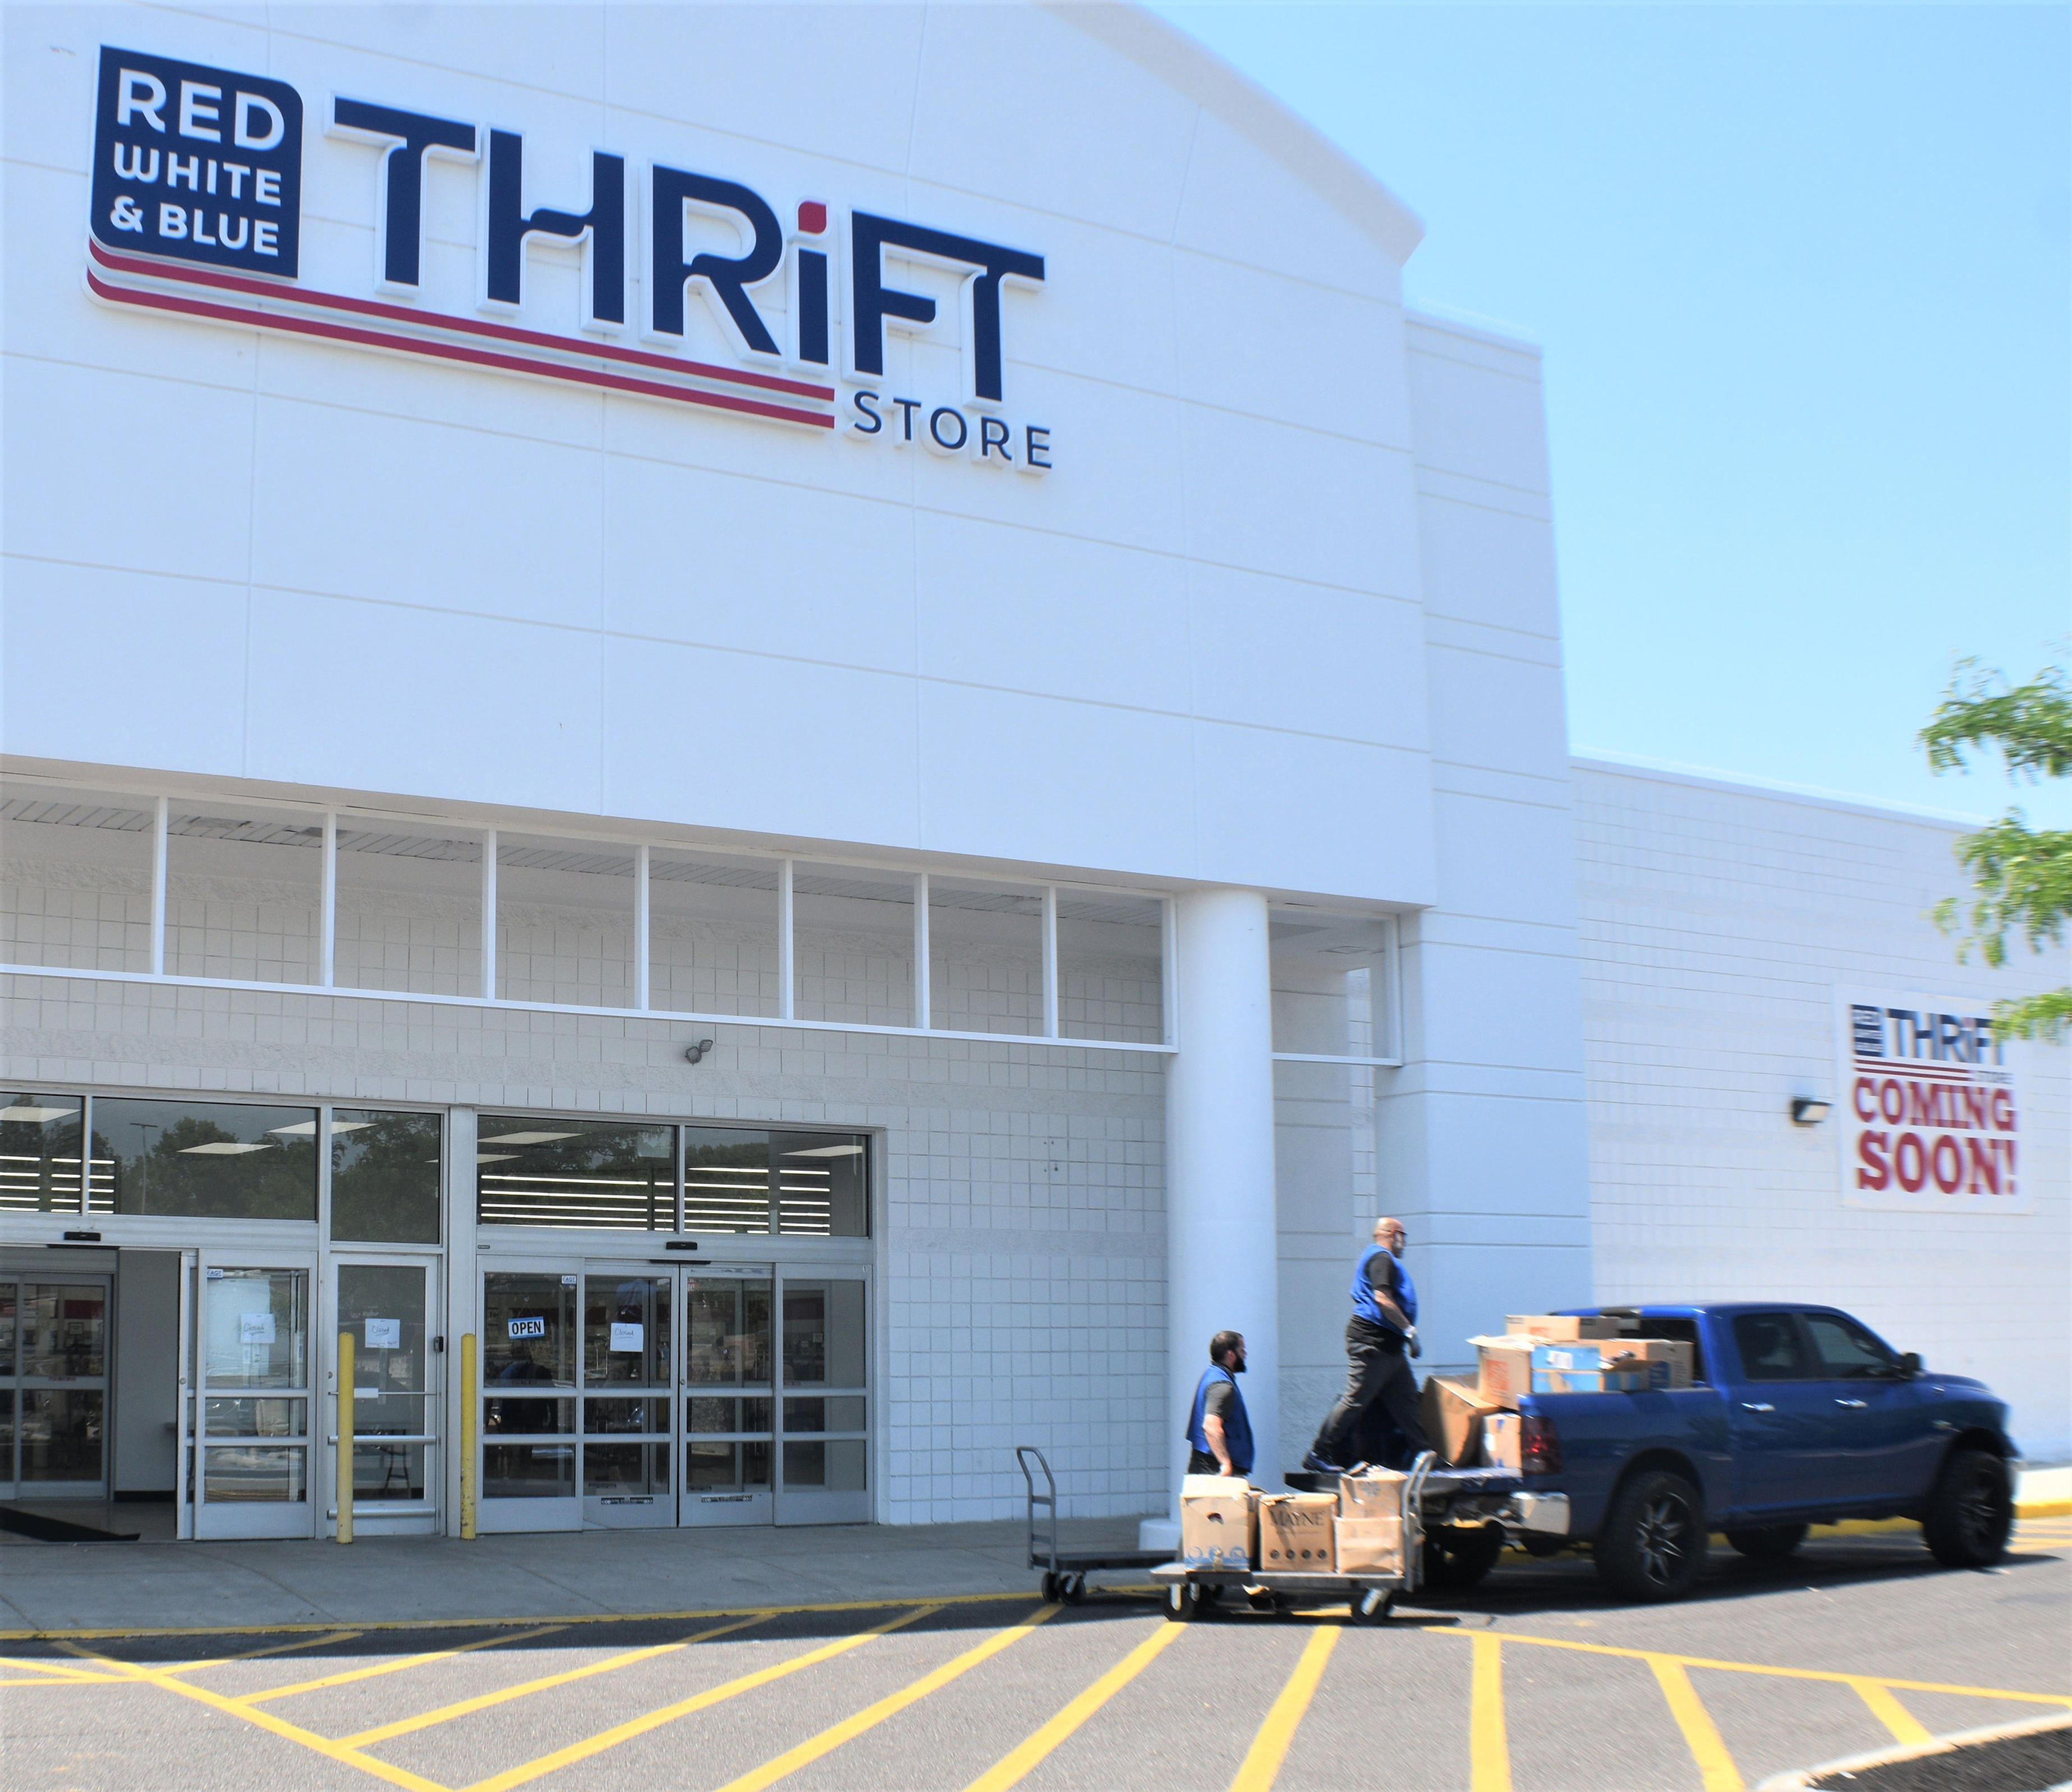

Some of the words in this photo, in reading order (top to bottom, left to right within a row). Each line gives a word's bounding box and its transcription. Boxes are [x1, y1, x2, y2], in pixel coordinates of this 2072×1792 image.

[117, 67, 285, 151] RED
[113, 142, 282, 207] WHITE
[110, 195, 144, 233] &
[159, 202, 279, 257] BLUE
[853, 390, 1053, 470] STORE
[1854, 1077, 2017, 1132] COMING
[1856, 1129, 2018, 1195] SOON!
[244, 1322, 265, 1332] Closed
[371, 1325, 389, 1334] Closed
[512, 1321, 541, 1335] OPEN
